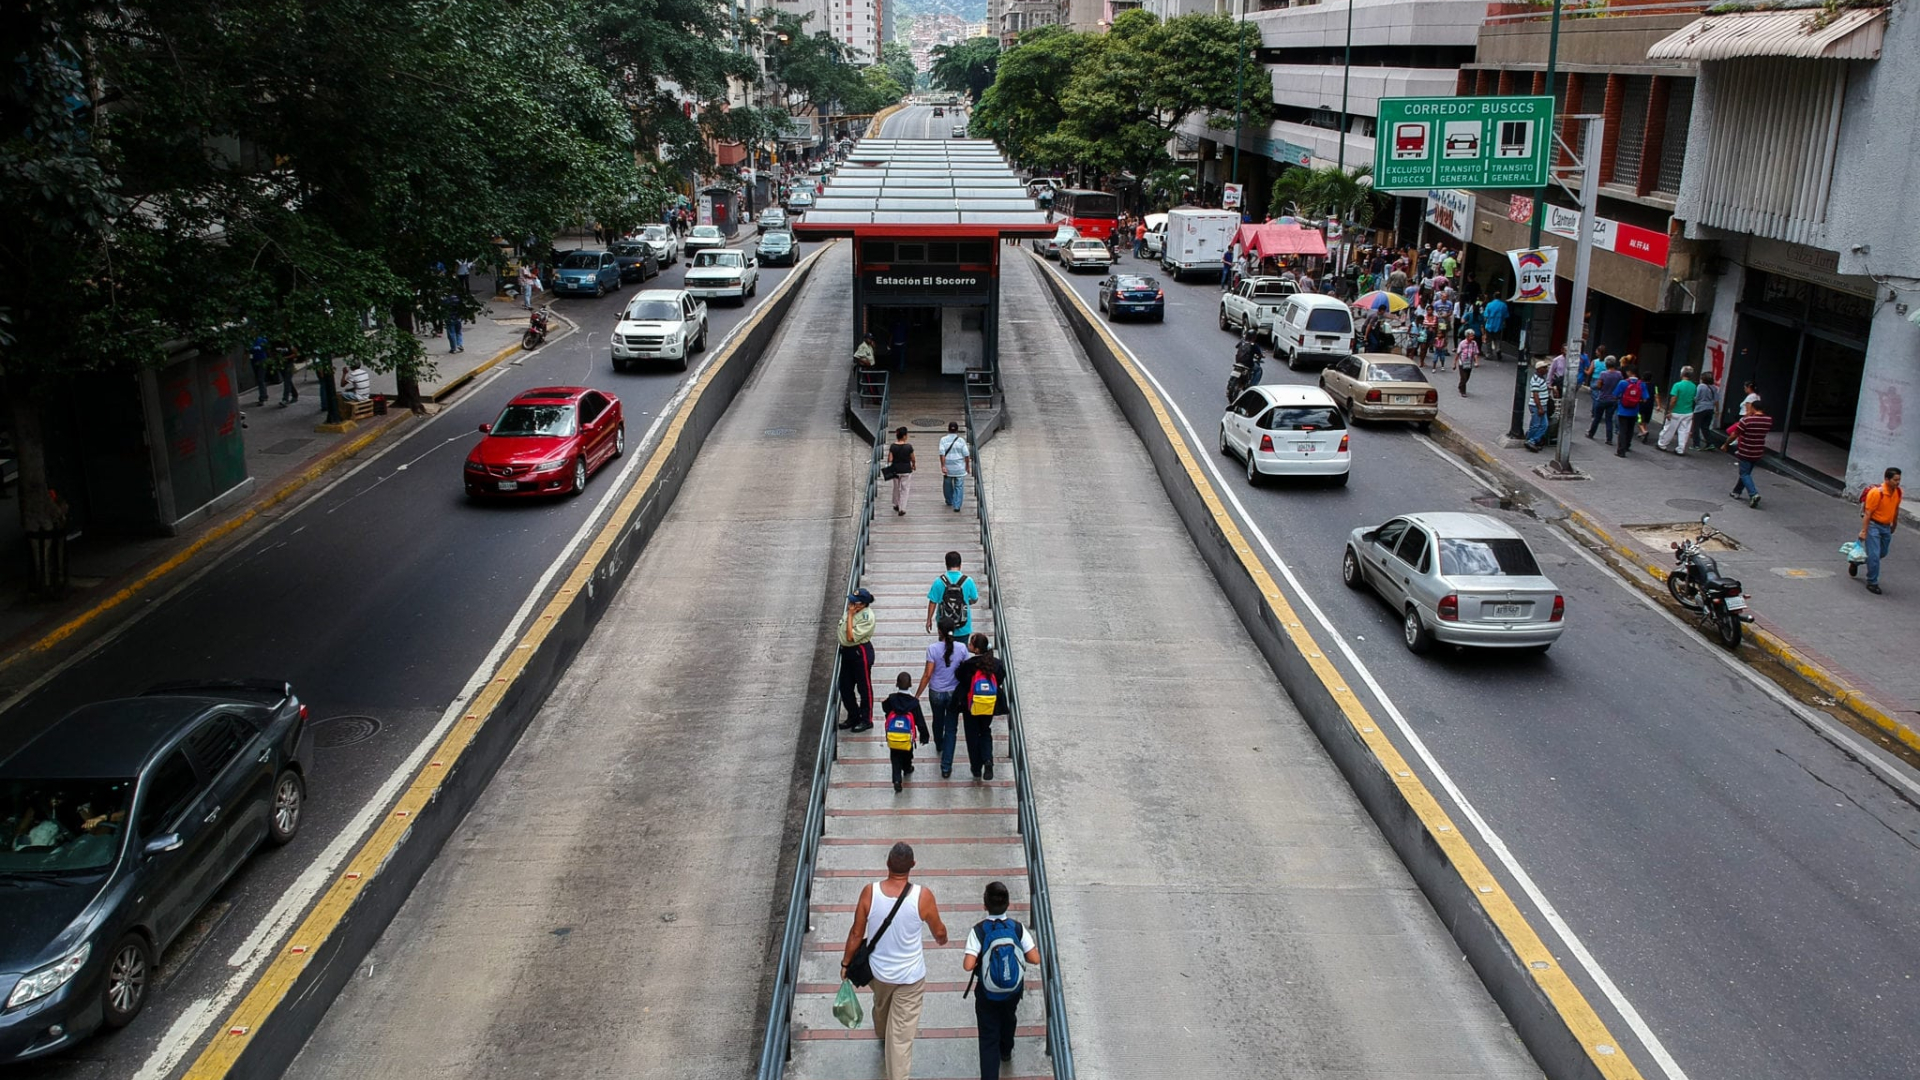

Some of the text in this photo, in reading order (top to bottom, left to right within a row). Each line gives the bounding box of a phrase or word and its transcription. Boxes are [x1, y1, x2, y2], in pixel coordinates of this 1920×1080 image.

[1481, 102, 1535, 114] BUSCCS
[1386, 166, 1432, 174] EXCLUSIVO
[1440, 164, 1482, 174] TRANSITO
[1491, 163, 1534, 173] TRANSITO
[1391, 175, 1425, 184] BUSCCS
[1440, 174, 1479, 183] GENERAL
[1491, 173, 1531, 182] GENERAL
[876, 276, 976, 285] Estación El Socorro
